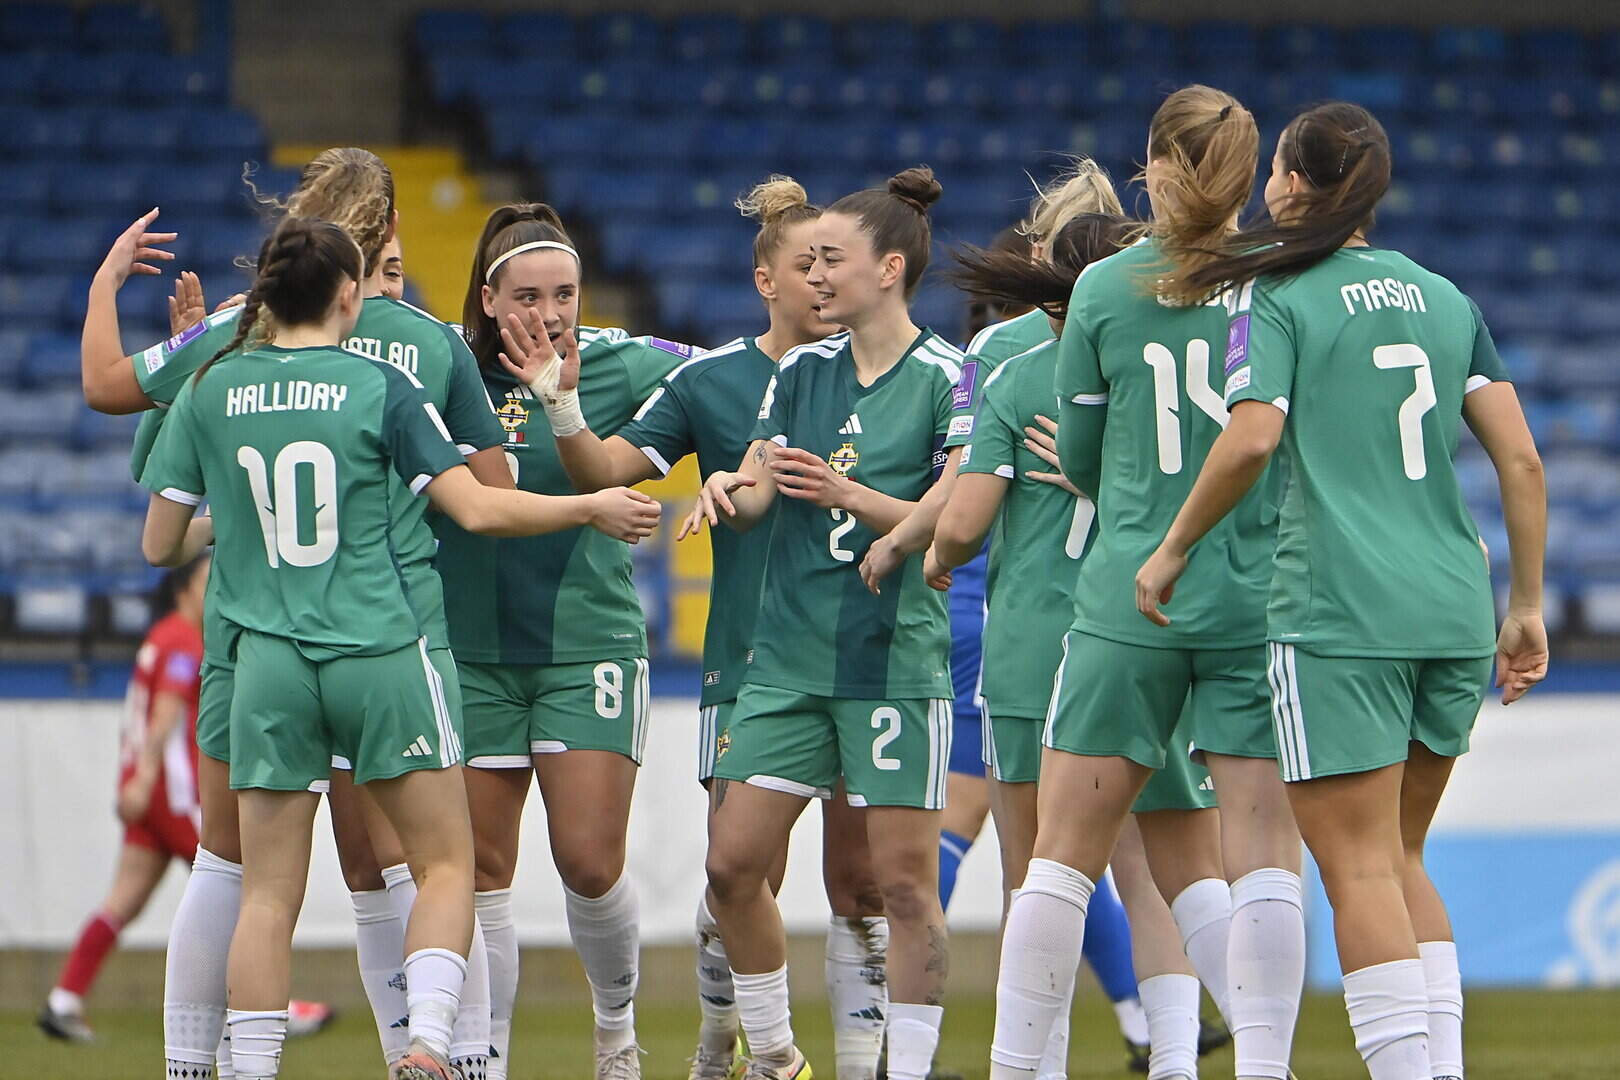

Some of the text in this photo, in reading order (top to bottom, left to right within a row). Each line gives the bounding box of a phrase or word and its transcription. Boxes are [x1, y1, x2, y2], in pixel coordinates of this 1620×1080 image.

[1340, 278, 1426, 315] MASON
[226, 380, 347, 417] HALLIDAY
[1373, 343, 1437, 480] 7
[237, 440, 338, 568] 10
[829, 507, 857, 562] 2
[593, 662, 623, 719] 8
[871, 706, 901, 770] 2
